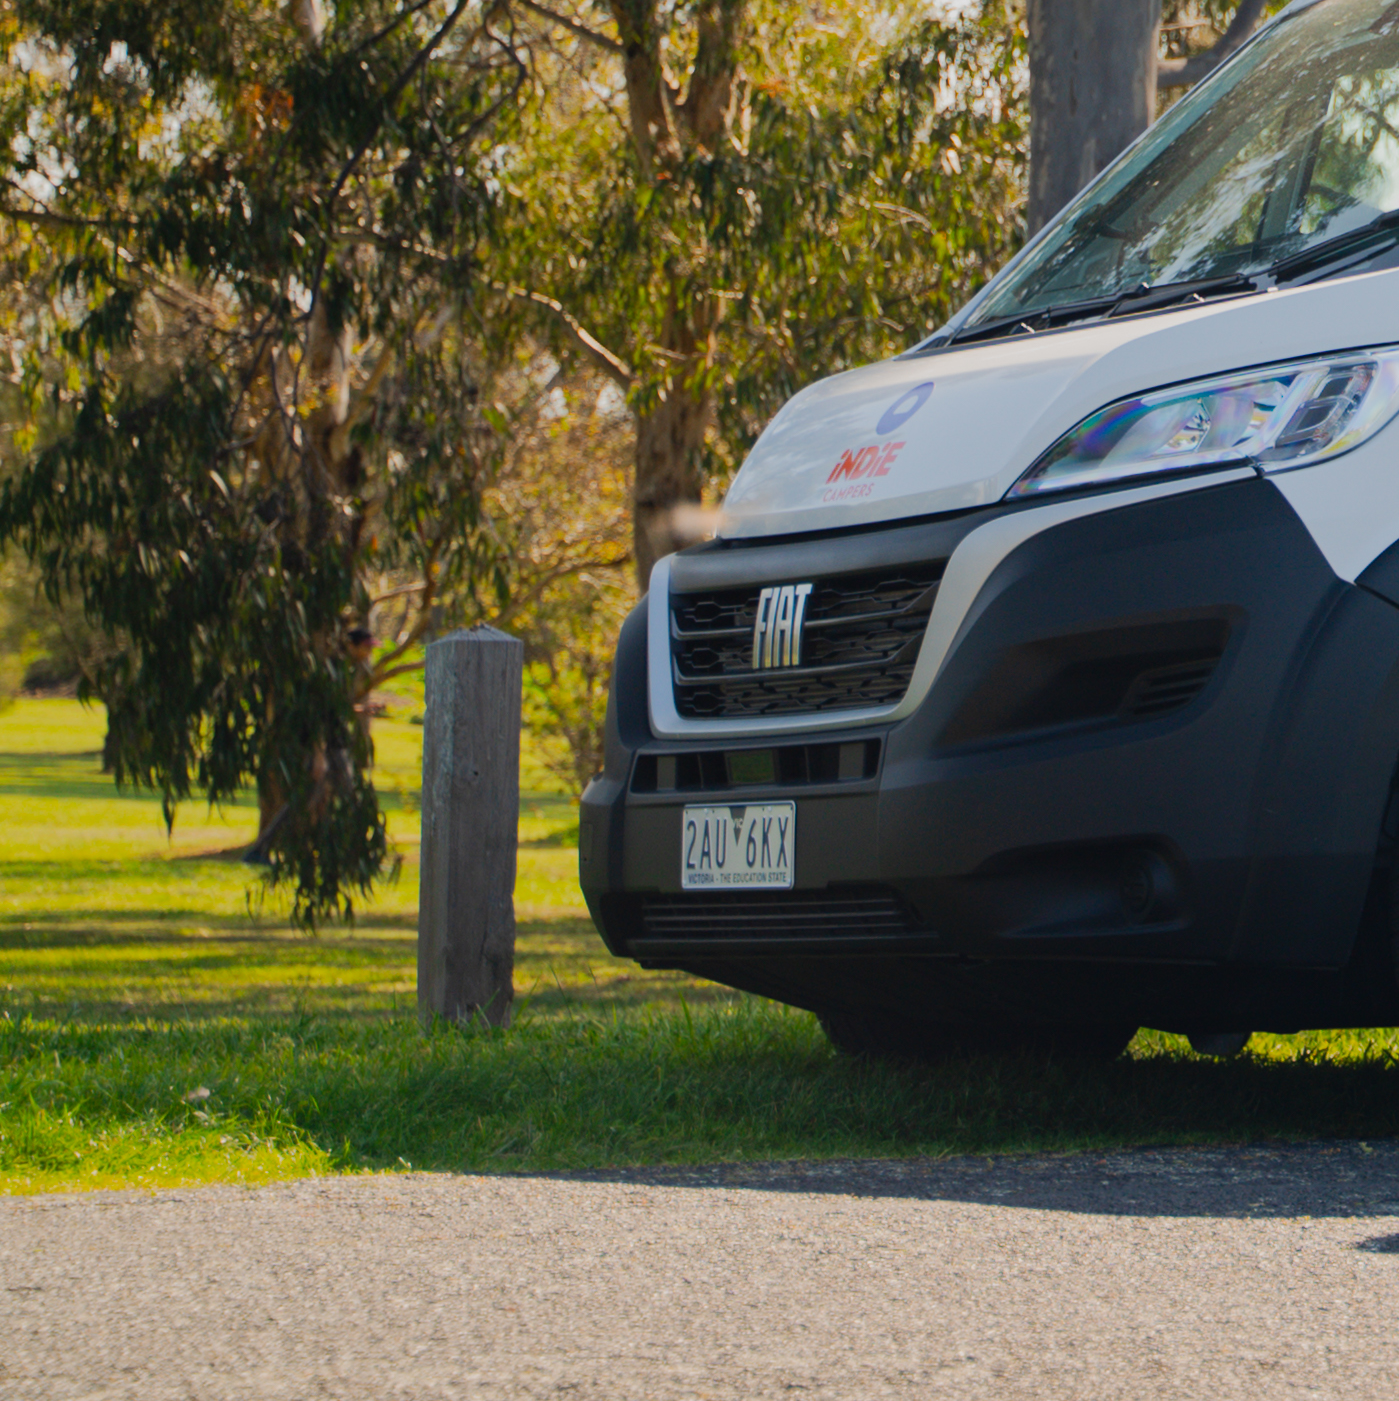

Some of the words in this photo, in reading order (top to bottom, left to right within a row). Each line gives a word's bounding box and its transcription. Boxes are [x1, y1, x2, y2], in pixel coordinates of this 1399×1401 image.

[823, 483, 875, 503] CAMPERS
[752, 583, 813, 669] FIAT
[687, 818, 727, 870] 2AU
[746, 816, 789, 868] 6KX
[688, 873, 714, 884] VICTORIA
[720, 873, 731, 884] THE
[733, 872, 767, 883] EDUCATION
[768, 871, 787, 883] STATE
